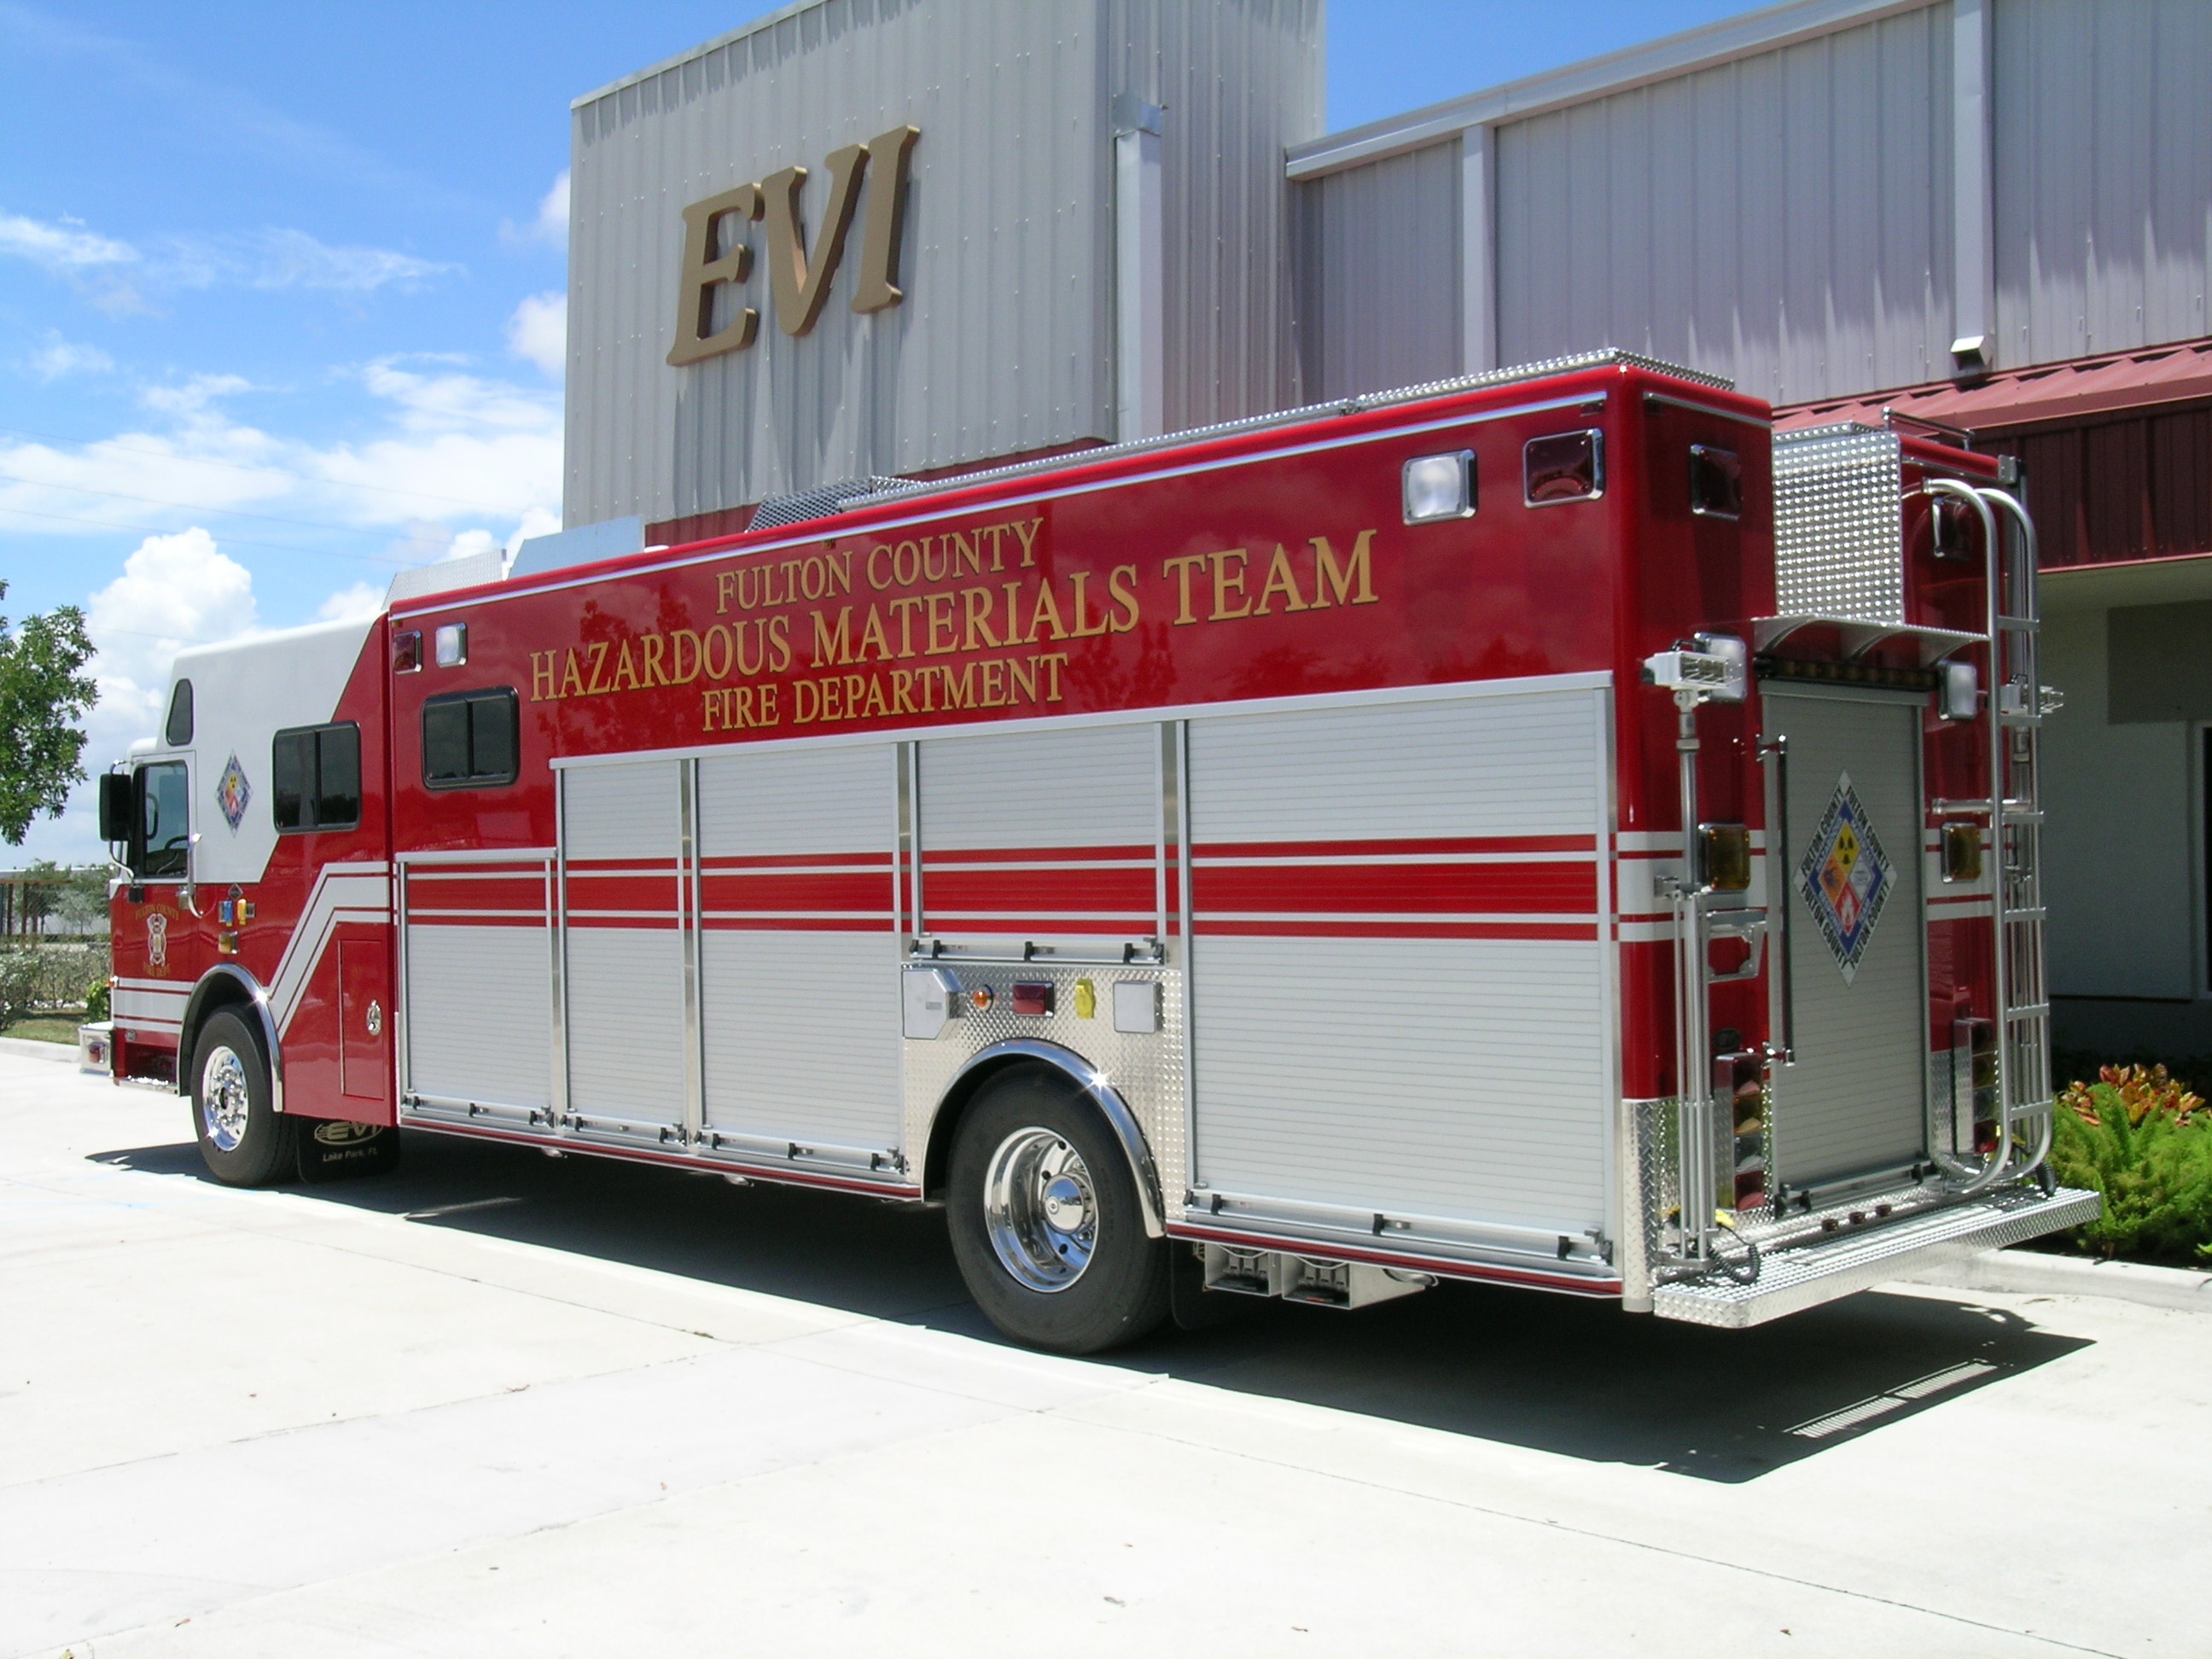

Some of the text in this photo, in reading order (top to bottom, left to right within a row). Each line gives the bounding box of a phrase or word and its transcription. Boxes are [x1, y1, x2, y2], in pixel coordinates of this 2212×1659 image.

[667, 125, 921, 367] EVI
[716, 517, 1045, 615] FULTON COUNTY
[529, 528, 1379, 702] HAZARDOUS MATERIALS TEAM
[701, 652, 1068, 732] FIRE DEPARTMENT
[1801, 831, 1823, 876] FULTON
[1821, 784, 1843, 835] COUNTY
[1846, 784, 1868, 830] FULTON
[1866, 825, 1890, 871] COUNTY
[1801, 882, 1825, 927] FULTON
[1823, 922, 1849, 969] COUNTY
[1848, 926, 1870, 970] FULTON
[1867, 881, 1890, 927] COUNTY
[323, 1152, 343, 1162] Lake
[368, 1147, 378, 1155] FL
